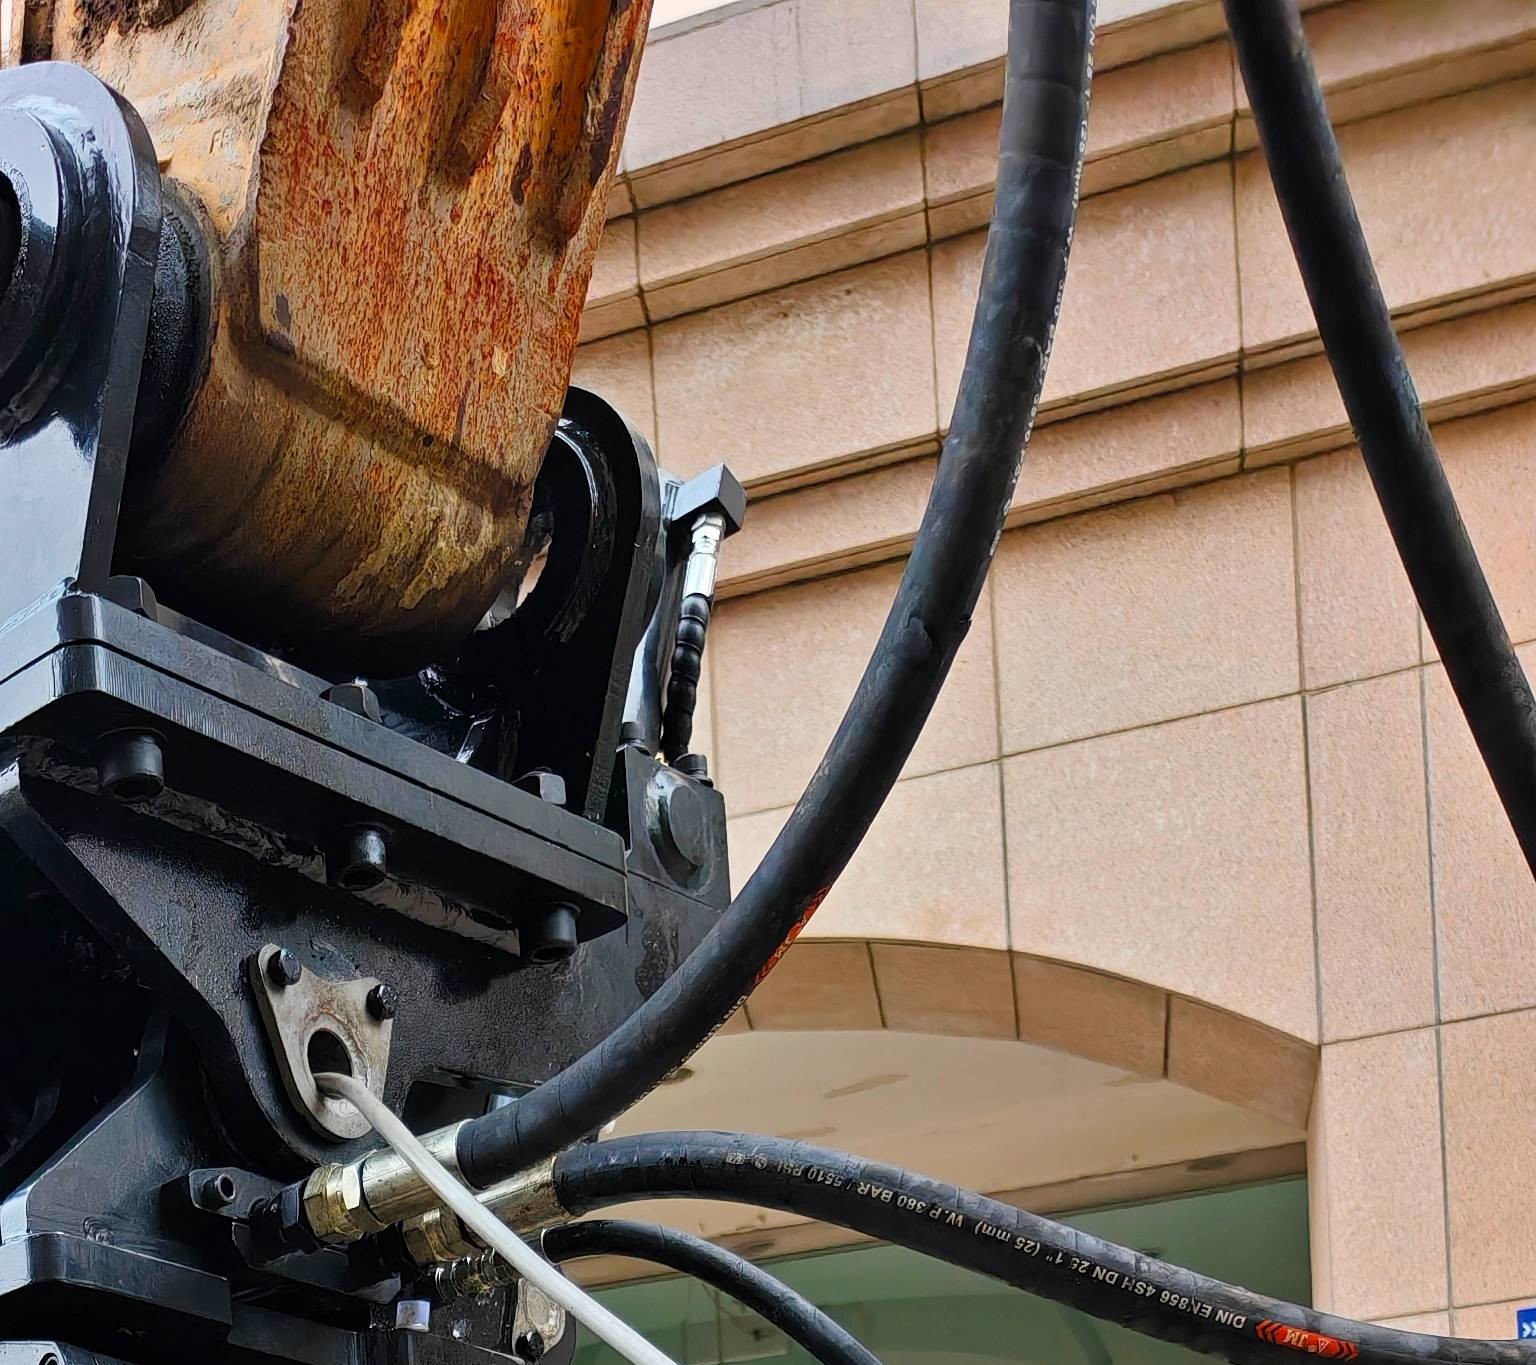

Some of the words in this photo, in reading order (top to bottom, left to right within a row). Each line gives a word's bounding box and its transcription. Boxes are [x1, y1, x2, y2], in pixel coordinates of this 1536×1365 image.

[807, 1167, 843, 1188] 5510
[856, 1180, 894, 1203] BAR
[896, 1194, 927, 1214] 380
[974, 1219, 1011, 1243] mm)
[1013, 1236, 1041, 1257] (25
[1069, 1257, 1090, 1274] 25
[1091, 1265, 1119, 1285] DN
[1120, 1275, 1157, 1298] 4SH
[1158, 1290, 1213, 1318] EN856
[1215, 1309, 1247, 1329] DIN
